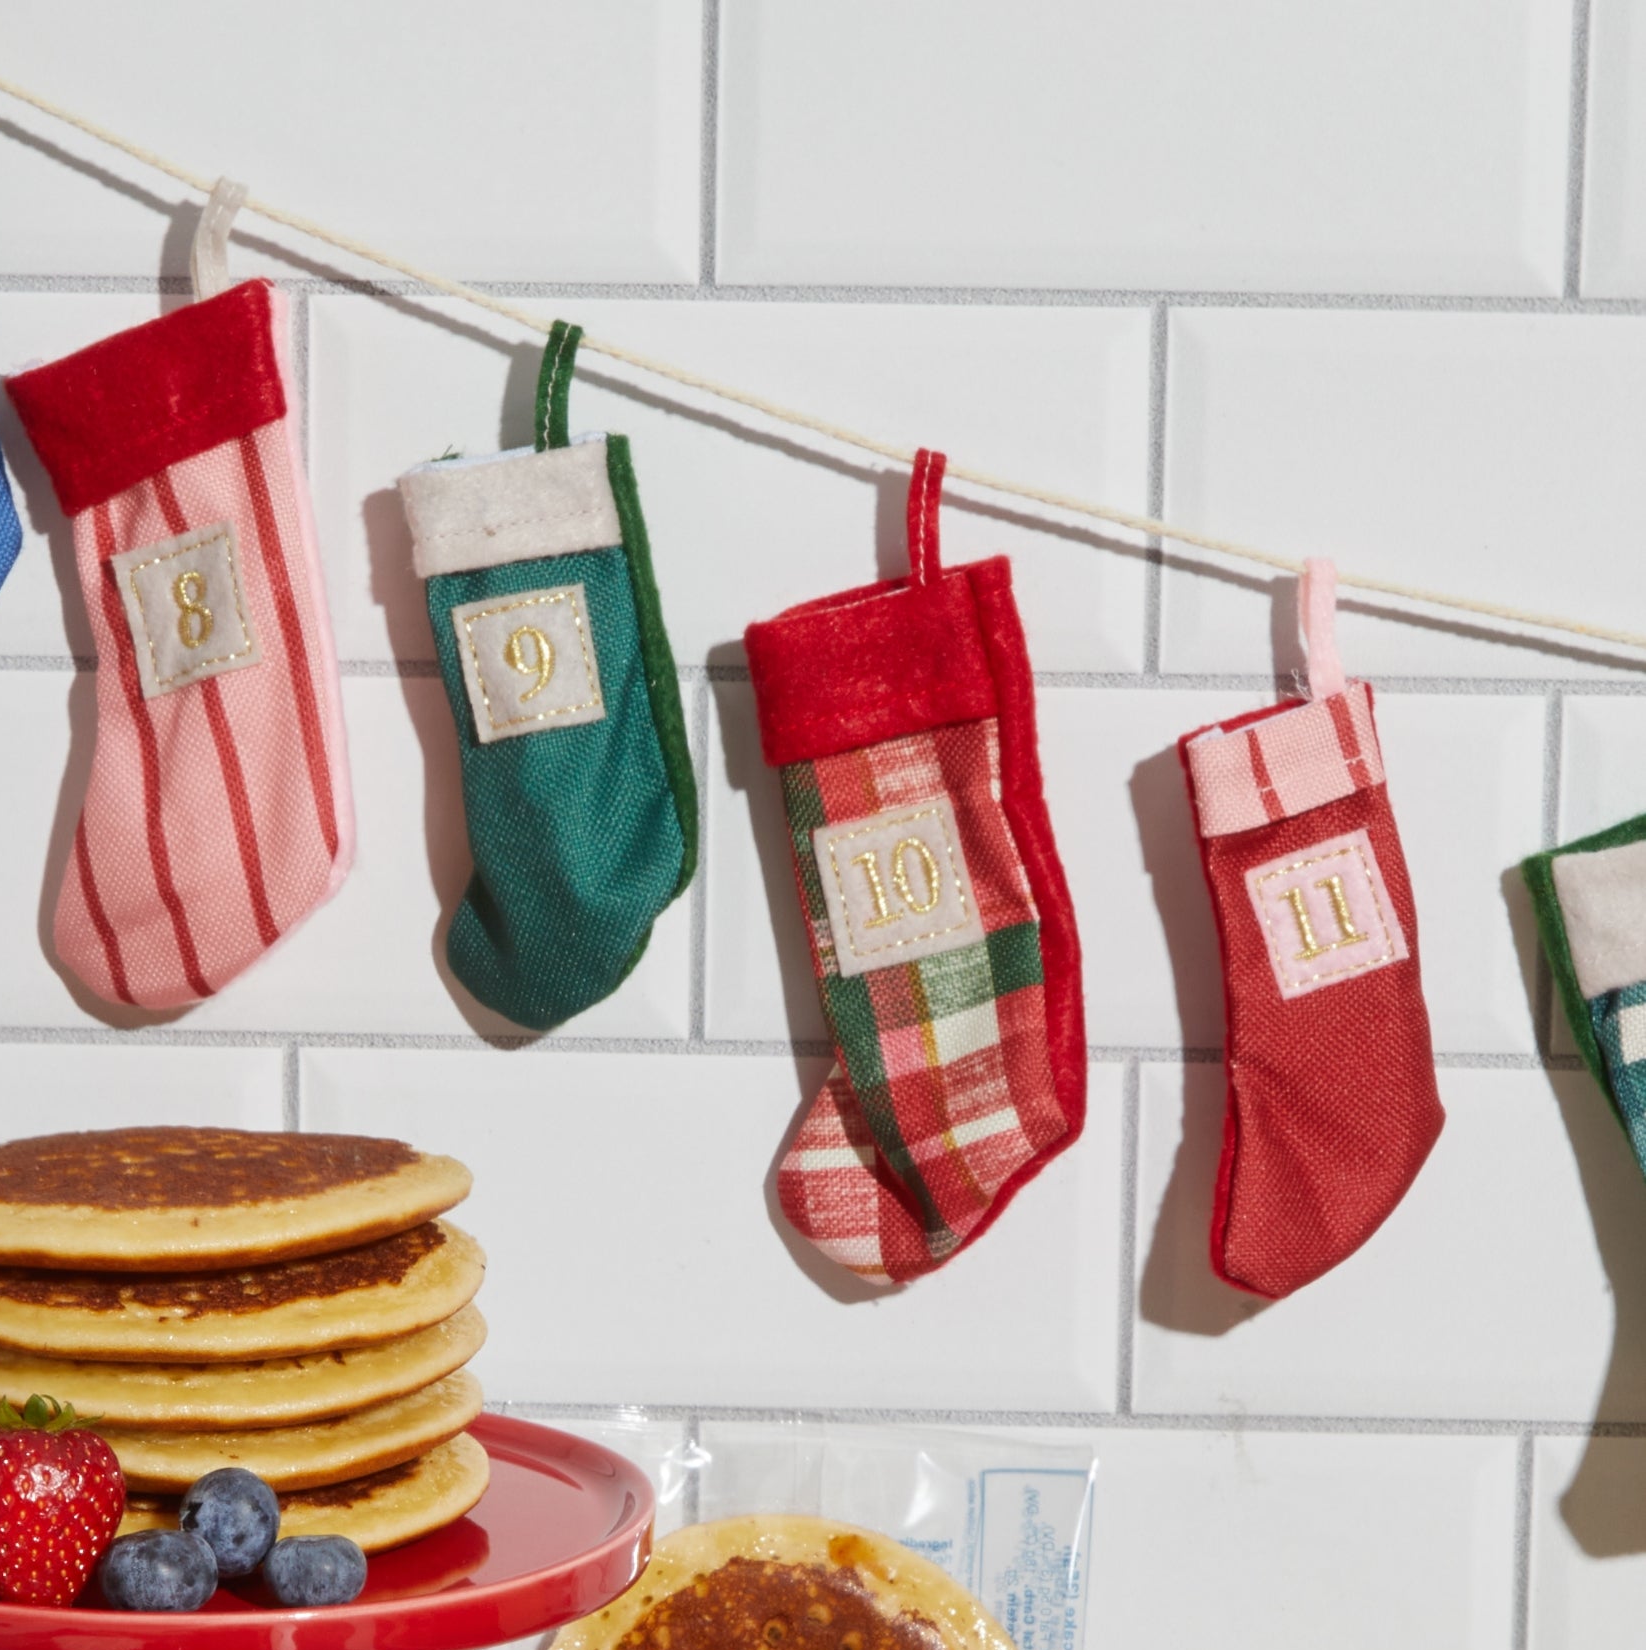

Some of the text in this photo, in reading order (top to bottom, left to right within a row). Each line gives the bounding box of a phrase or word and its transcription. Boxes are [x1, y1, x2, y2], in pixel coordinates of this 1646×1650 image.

[171, 570, 215, 649] 8
[502, 625, 554, 703] 9
[850, 835, 941, 930] 10
[1278, 875, 1369, 962] 11
